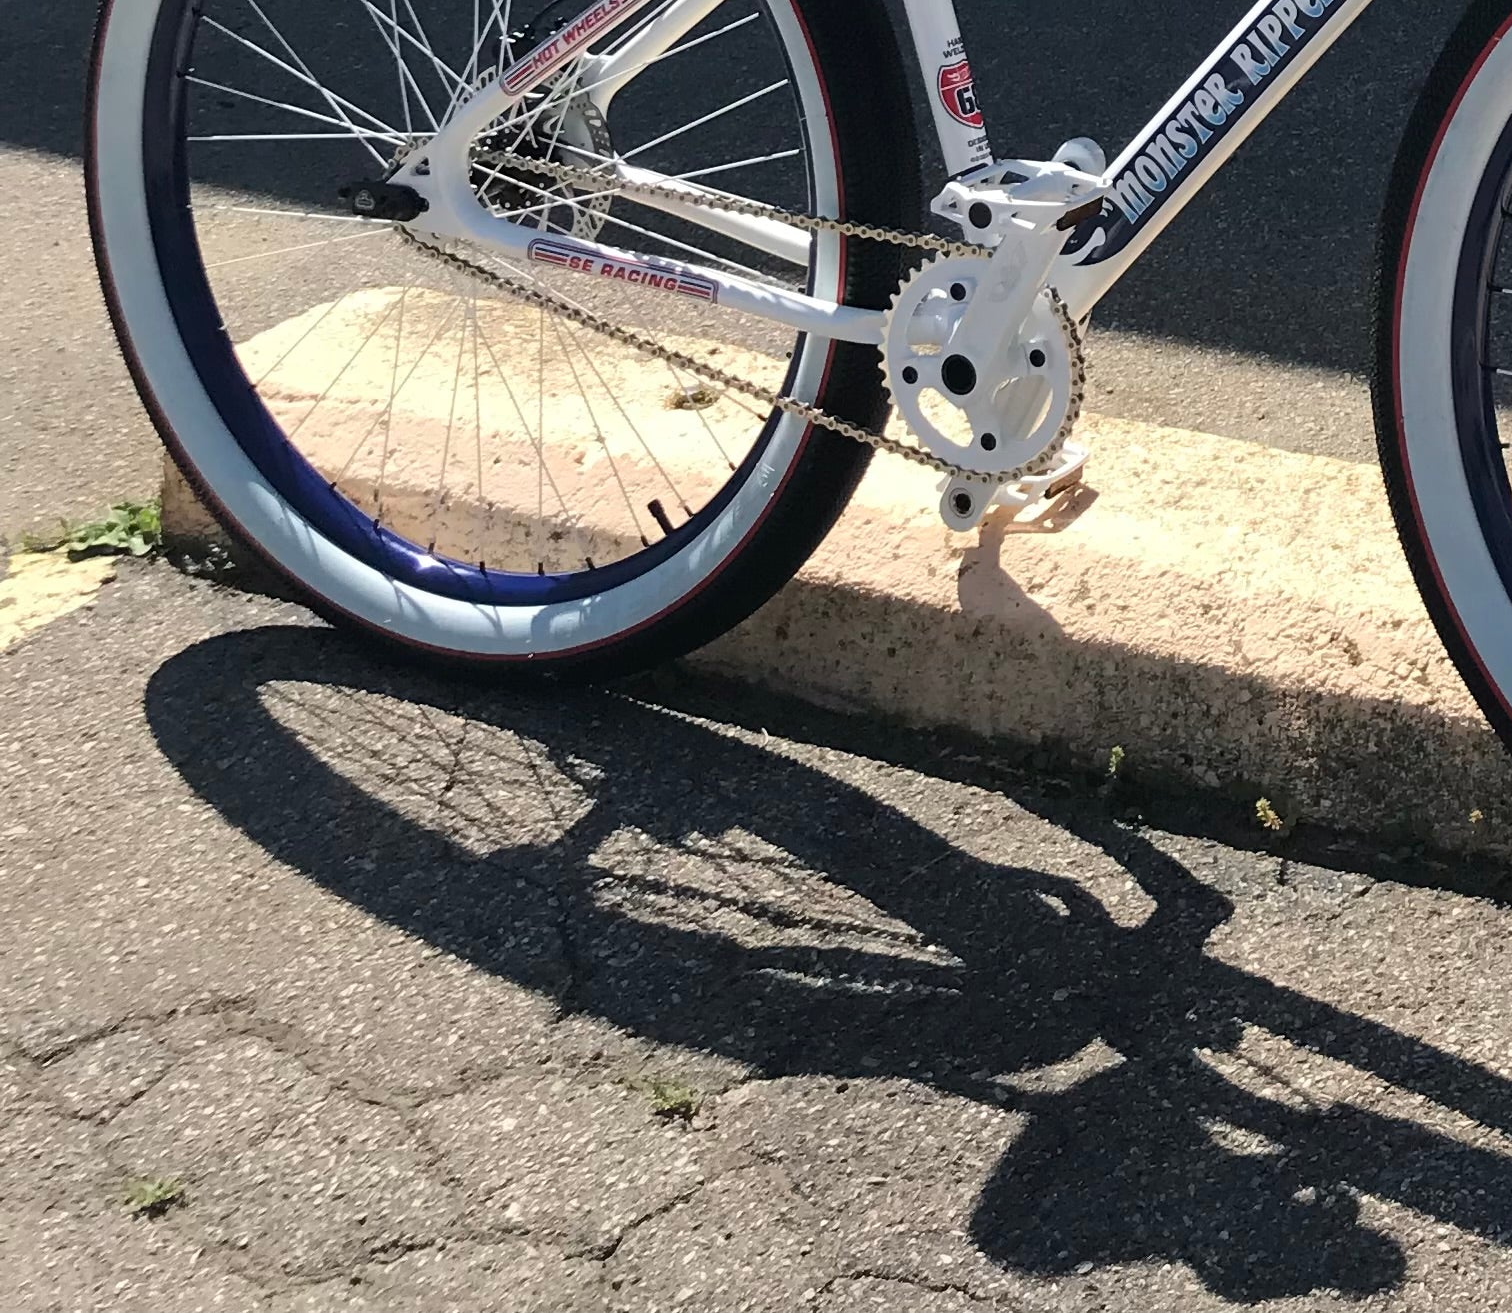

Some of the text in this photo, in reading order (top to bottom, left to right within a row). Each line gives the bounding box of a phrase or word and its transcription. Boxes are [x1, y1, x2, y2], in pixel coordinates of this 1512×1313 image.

[532, 38, 562, 70] HOT
[569, 255, 679, 291] SE RACING
